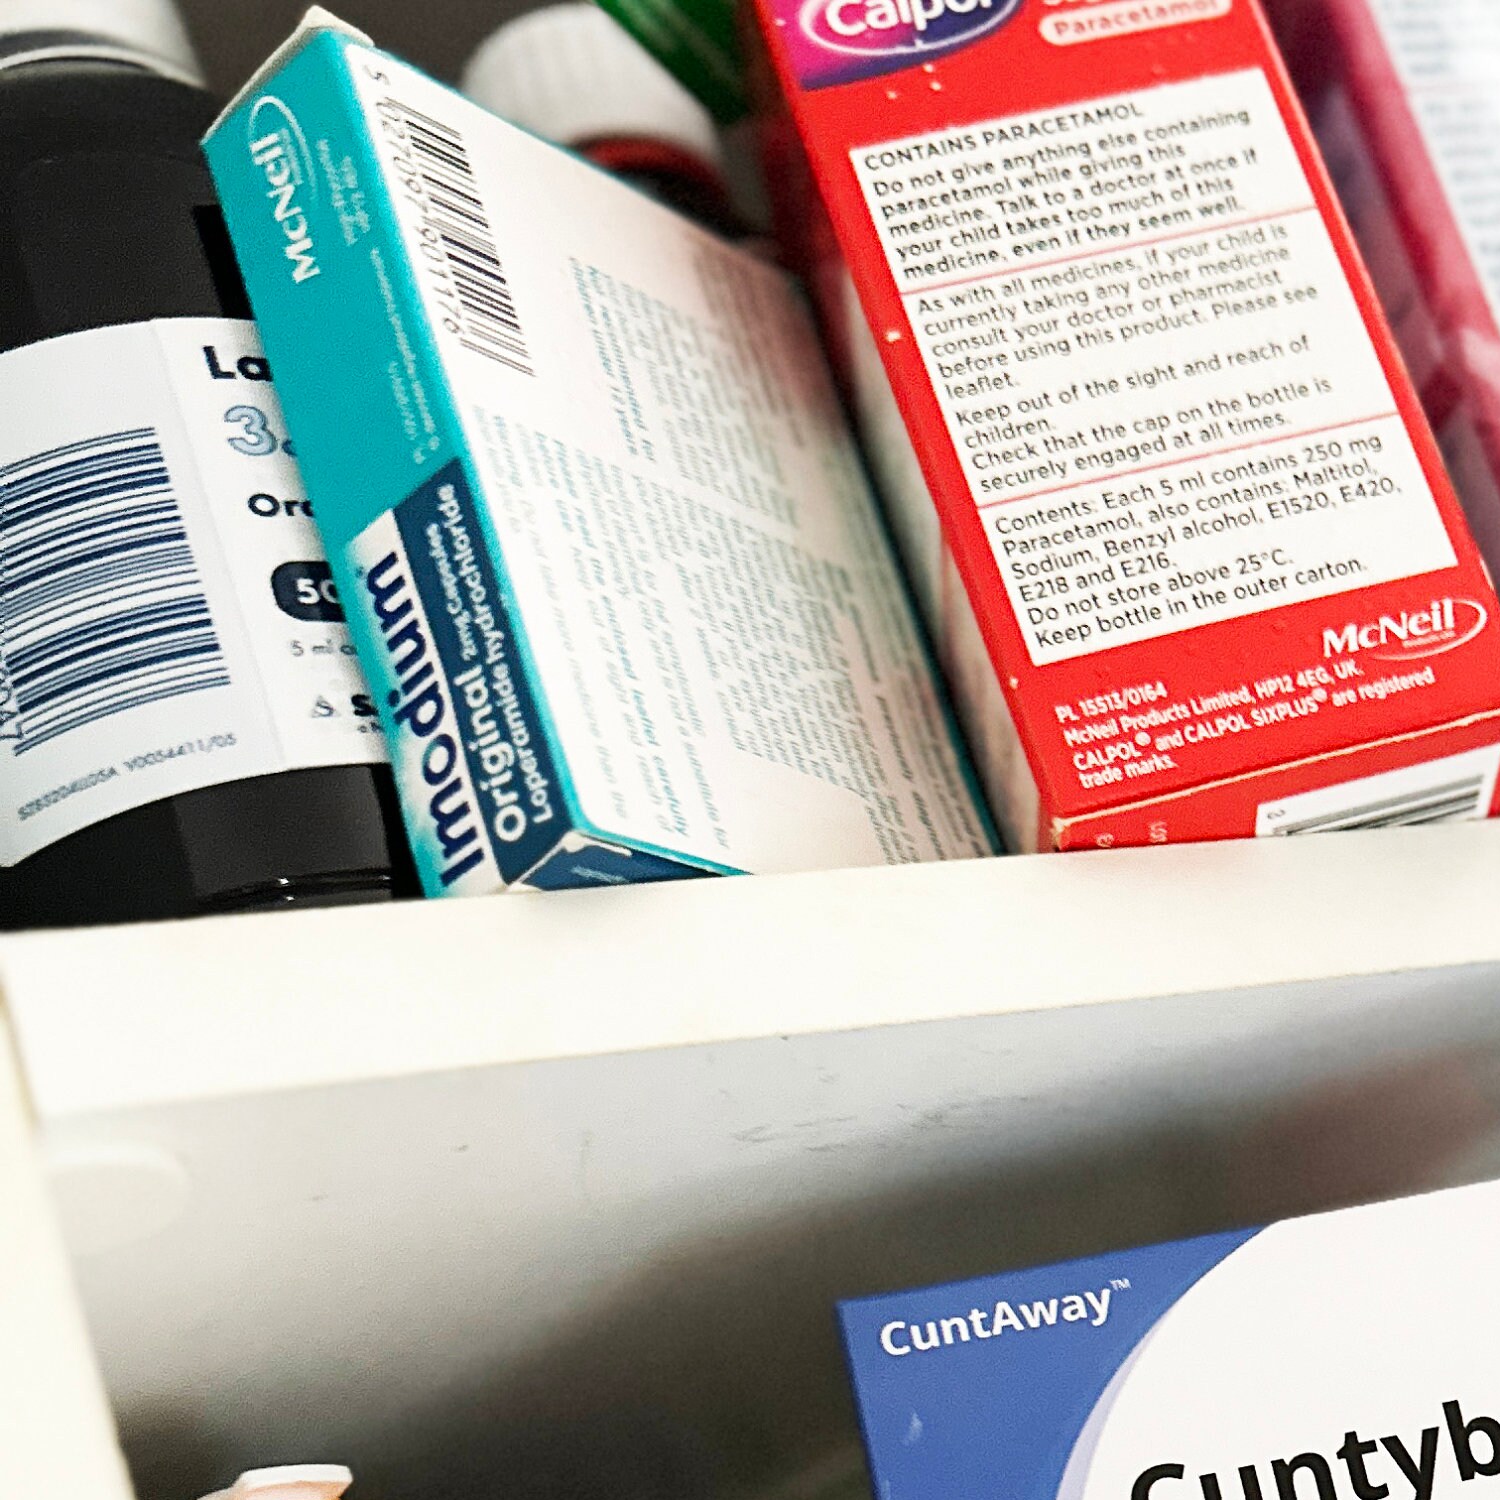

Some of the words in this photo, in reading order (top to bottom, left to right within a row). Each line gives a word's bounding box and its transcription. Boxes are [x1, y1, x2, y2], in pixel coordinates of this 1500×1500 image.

[863, 134, 978, 171] CONTAINS
[981, 102, 1144, 147] PARACETAMOL
[872, 179, 905, 197] Do
[908, 169, 946, 190] not
[950, 161, 996, 185] give
[1001, 141, 1093, 171] anything
[1097, 132, 1138, 151] else
[1143, 110, 1251, 142] containing
[248, 129, 321, 285] McNeil
[202, 344, 274, 382] La
[247, 492, 315, 518] Or
[994, 500, 1099, 535] Contents:
[1100, 484, 1157, 510] Each
[1159, 478, 1175, 497] 5
[1178, 471, 1207, 492] ml
[1210, 454, 1299, 485] contains
[1302, 440, 1343, 464] 250
[1348, 435, 1383, 455] mg
[1001, 510, 1144, 558] Paracetamol,
[1147, 502, 1190, 524] also
[1195, 481, 1289, 512] contains:
[1292, 457, 1378, 490] Maltitol,
[1010, 549, 1101, 581] Sodium,
[1102, 525, 1177, 558] Benzyl
[1181, 506, 1264, 541] alcohol,
[1265, 491, 1337, 520] E1520,
[1338, 476, 1402, 504] E420,
[436, 483, 507, 667] hydrochloride
[1017, 575, 1070, 603] E218
[1075, 563, 1117, 590] and
[1119, 551, 1178, 579] E216.
[1033, 623, 1093, 649] Keep
[1094, 604, 1163, 634] bottle
[1165, 598, 1189, 616] in
[1190, 590, 1228, 610] the
[1233, 575, 1288, 600] outer
[1294, 558, 1368, 586] carton.
[1322, 595, 1456, 659] McNeil
[364, 549, 485, 888] Imodium
[491, 664, 552, 825] Loperamide
[1054, 703, 1081, 724] PL
[1078, 680, 1169, 718] 15513/0164
[1062, 716, 1120, 748] McNeil
[1119, 702, 1192, 734] Products
[1189, 684, 1257, 716] Limited,
[1253, 673, 1297, 700] HP12
[1295, 664, 1337, 692] 4EG,
[1331, 657, 1365, 680] UK.
[454, 667, 528, 843] Original
[1076, 760, 1125, 789] trade
[1122, 746, 1180, 779] marks.
